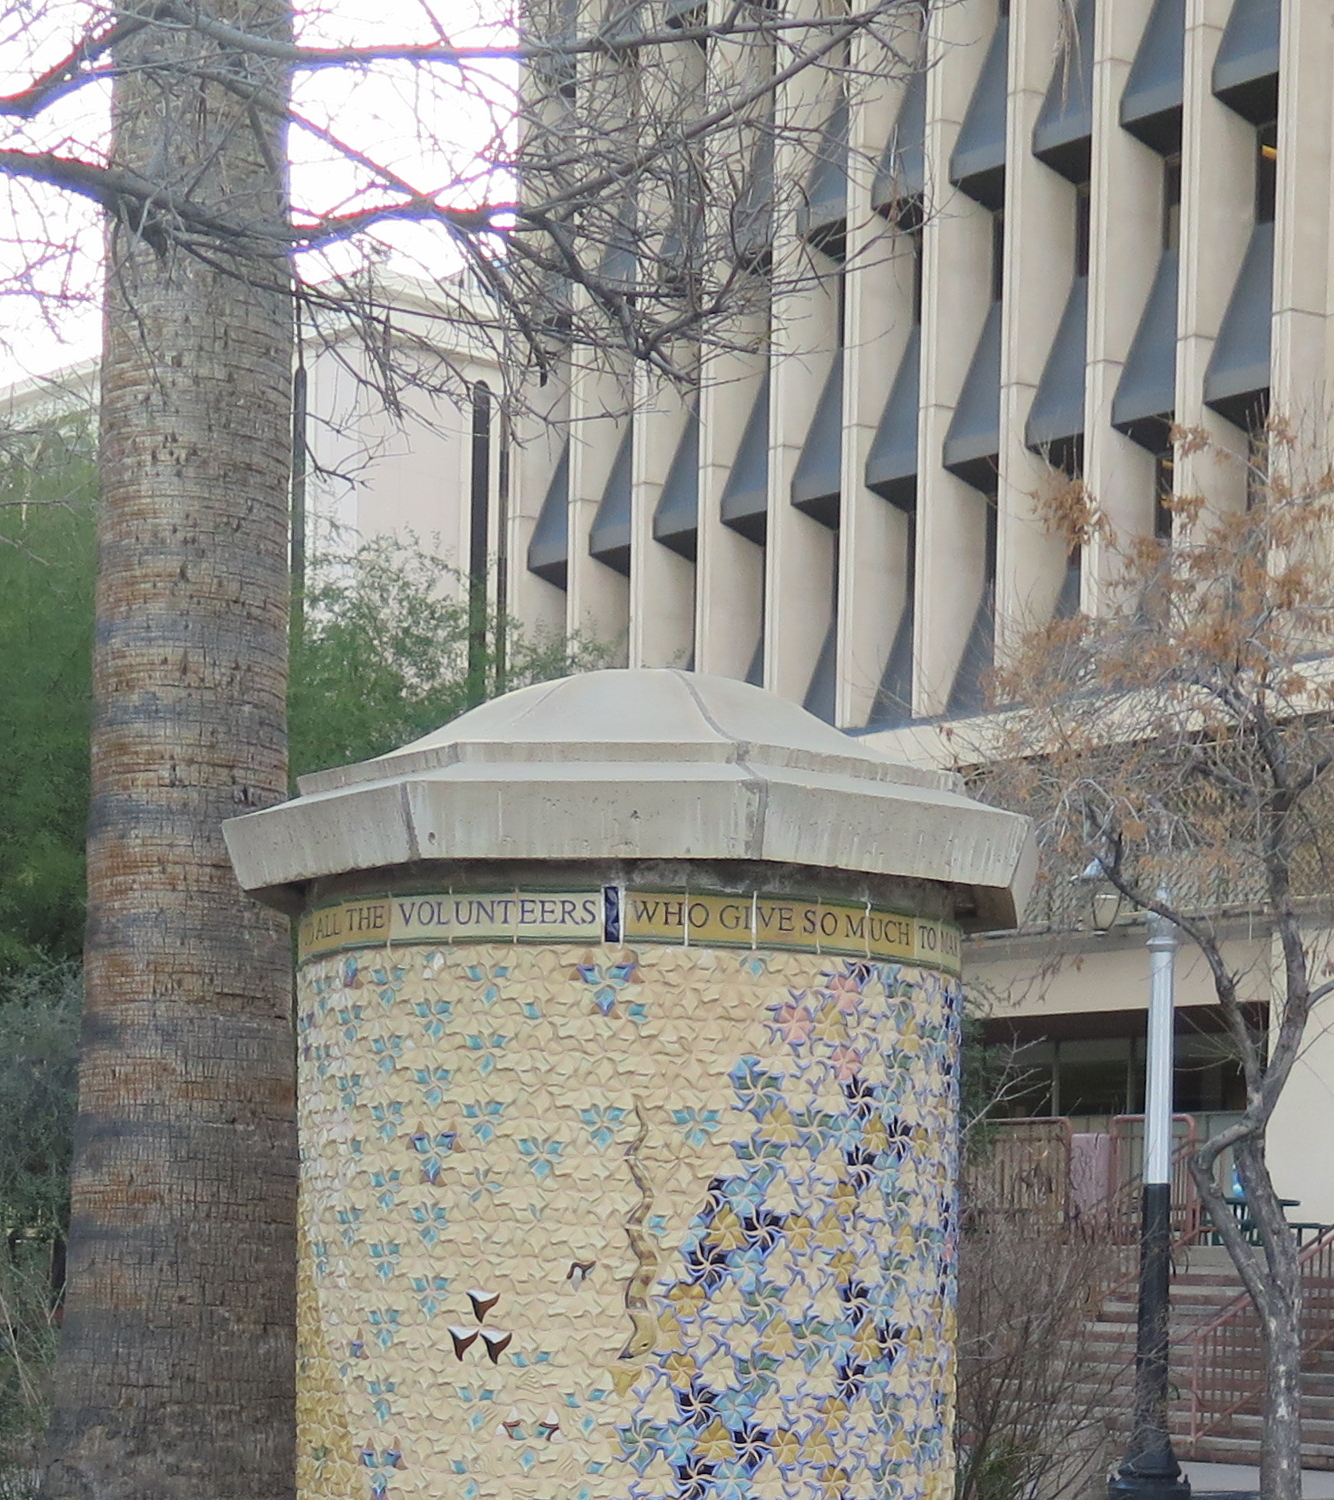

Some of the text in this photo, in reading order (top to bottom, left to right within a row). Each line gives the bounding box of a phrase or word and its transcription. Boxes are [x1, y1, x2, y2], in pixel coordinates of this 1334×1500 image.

[314, 913, 341, 940] ALL
[346, 905, 385, 930] THE
[398, 899, 597, 927] VOLUNTEERS
[633, 899, 710, 928] WHO
[719, 903, 795, 932] GIVE
[803, 908, 838, 938] SO
[844, 914, 910, 946] MUCH
[918, 925, 937, 951] TO
